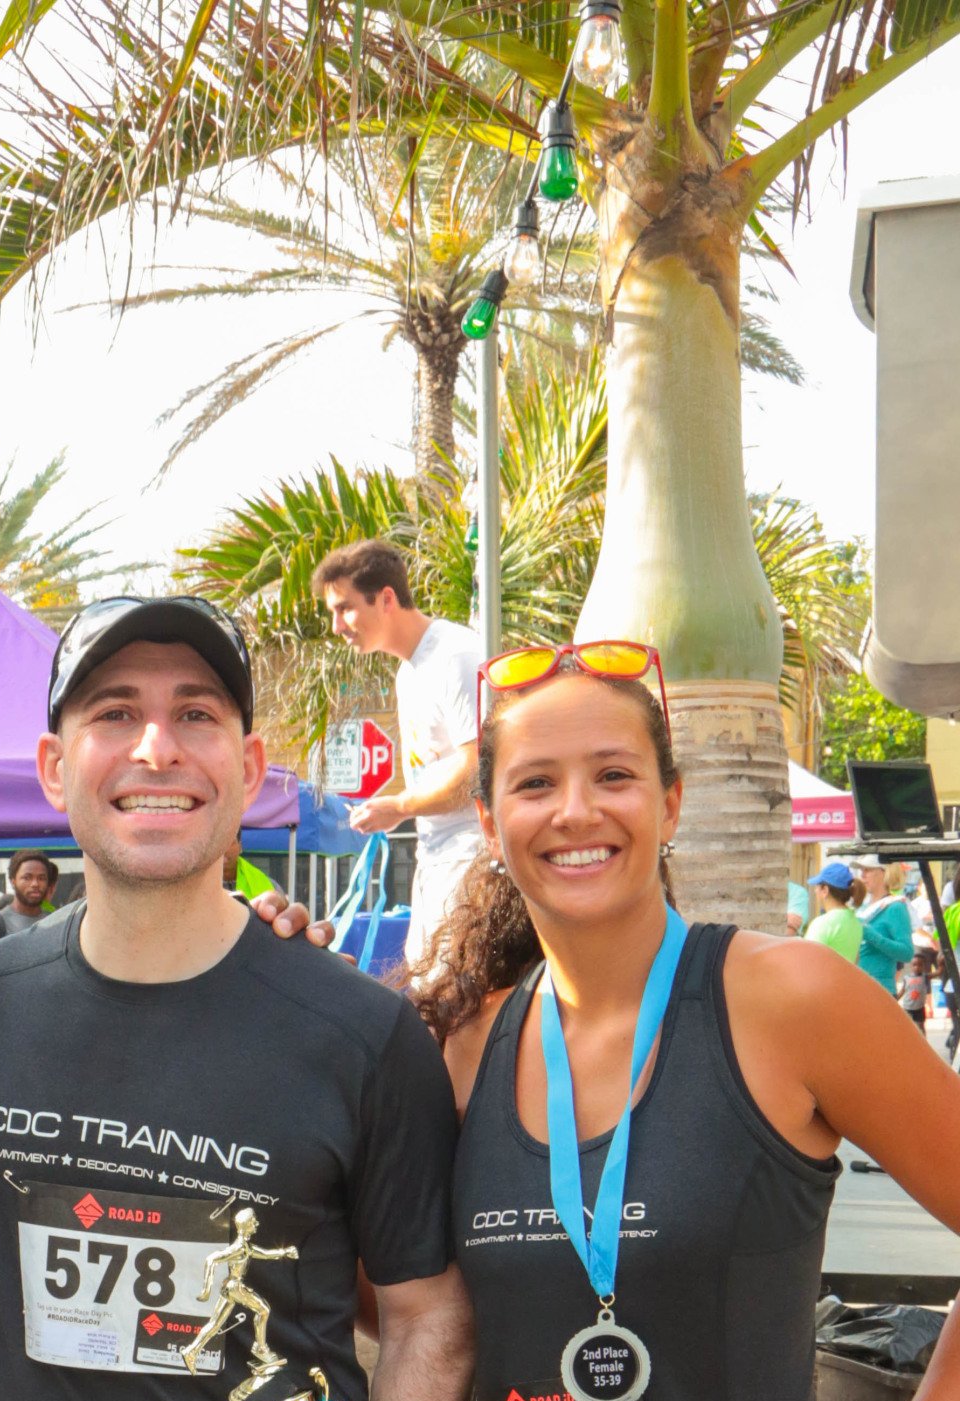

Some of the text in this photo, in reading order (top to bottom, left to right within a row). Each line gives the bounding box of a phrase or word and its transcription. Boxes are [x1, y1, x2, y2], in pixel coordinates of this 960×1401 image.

[72, 1114, 271, 1176] TRAINING
[77, 1157, 154, 1180] DEDICATION
[172, 1175, 280, 1206] CONSISTENCY
[108, 1206, 144, 1223] ROAD
[473, 1210, 518, 1229] CDC
[470, 1234, 515, 1246] COMMITMENT
[526, 1233, 570, 1242] DEDICATIO
[44, 1235, 176, 1308] 578
[166, 1322, 192, 1333] ROAD
[582, 1347, 629, 1360] 2nd Place
[589, 1361, 624, 1373] Female
[594, 1375, 622, 1387] 35-39
